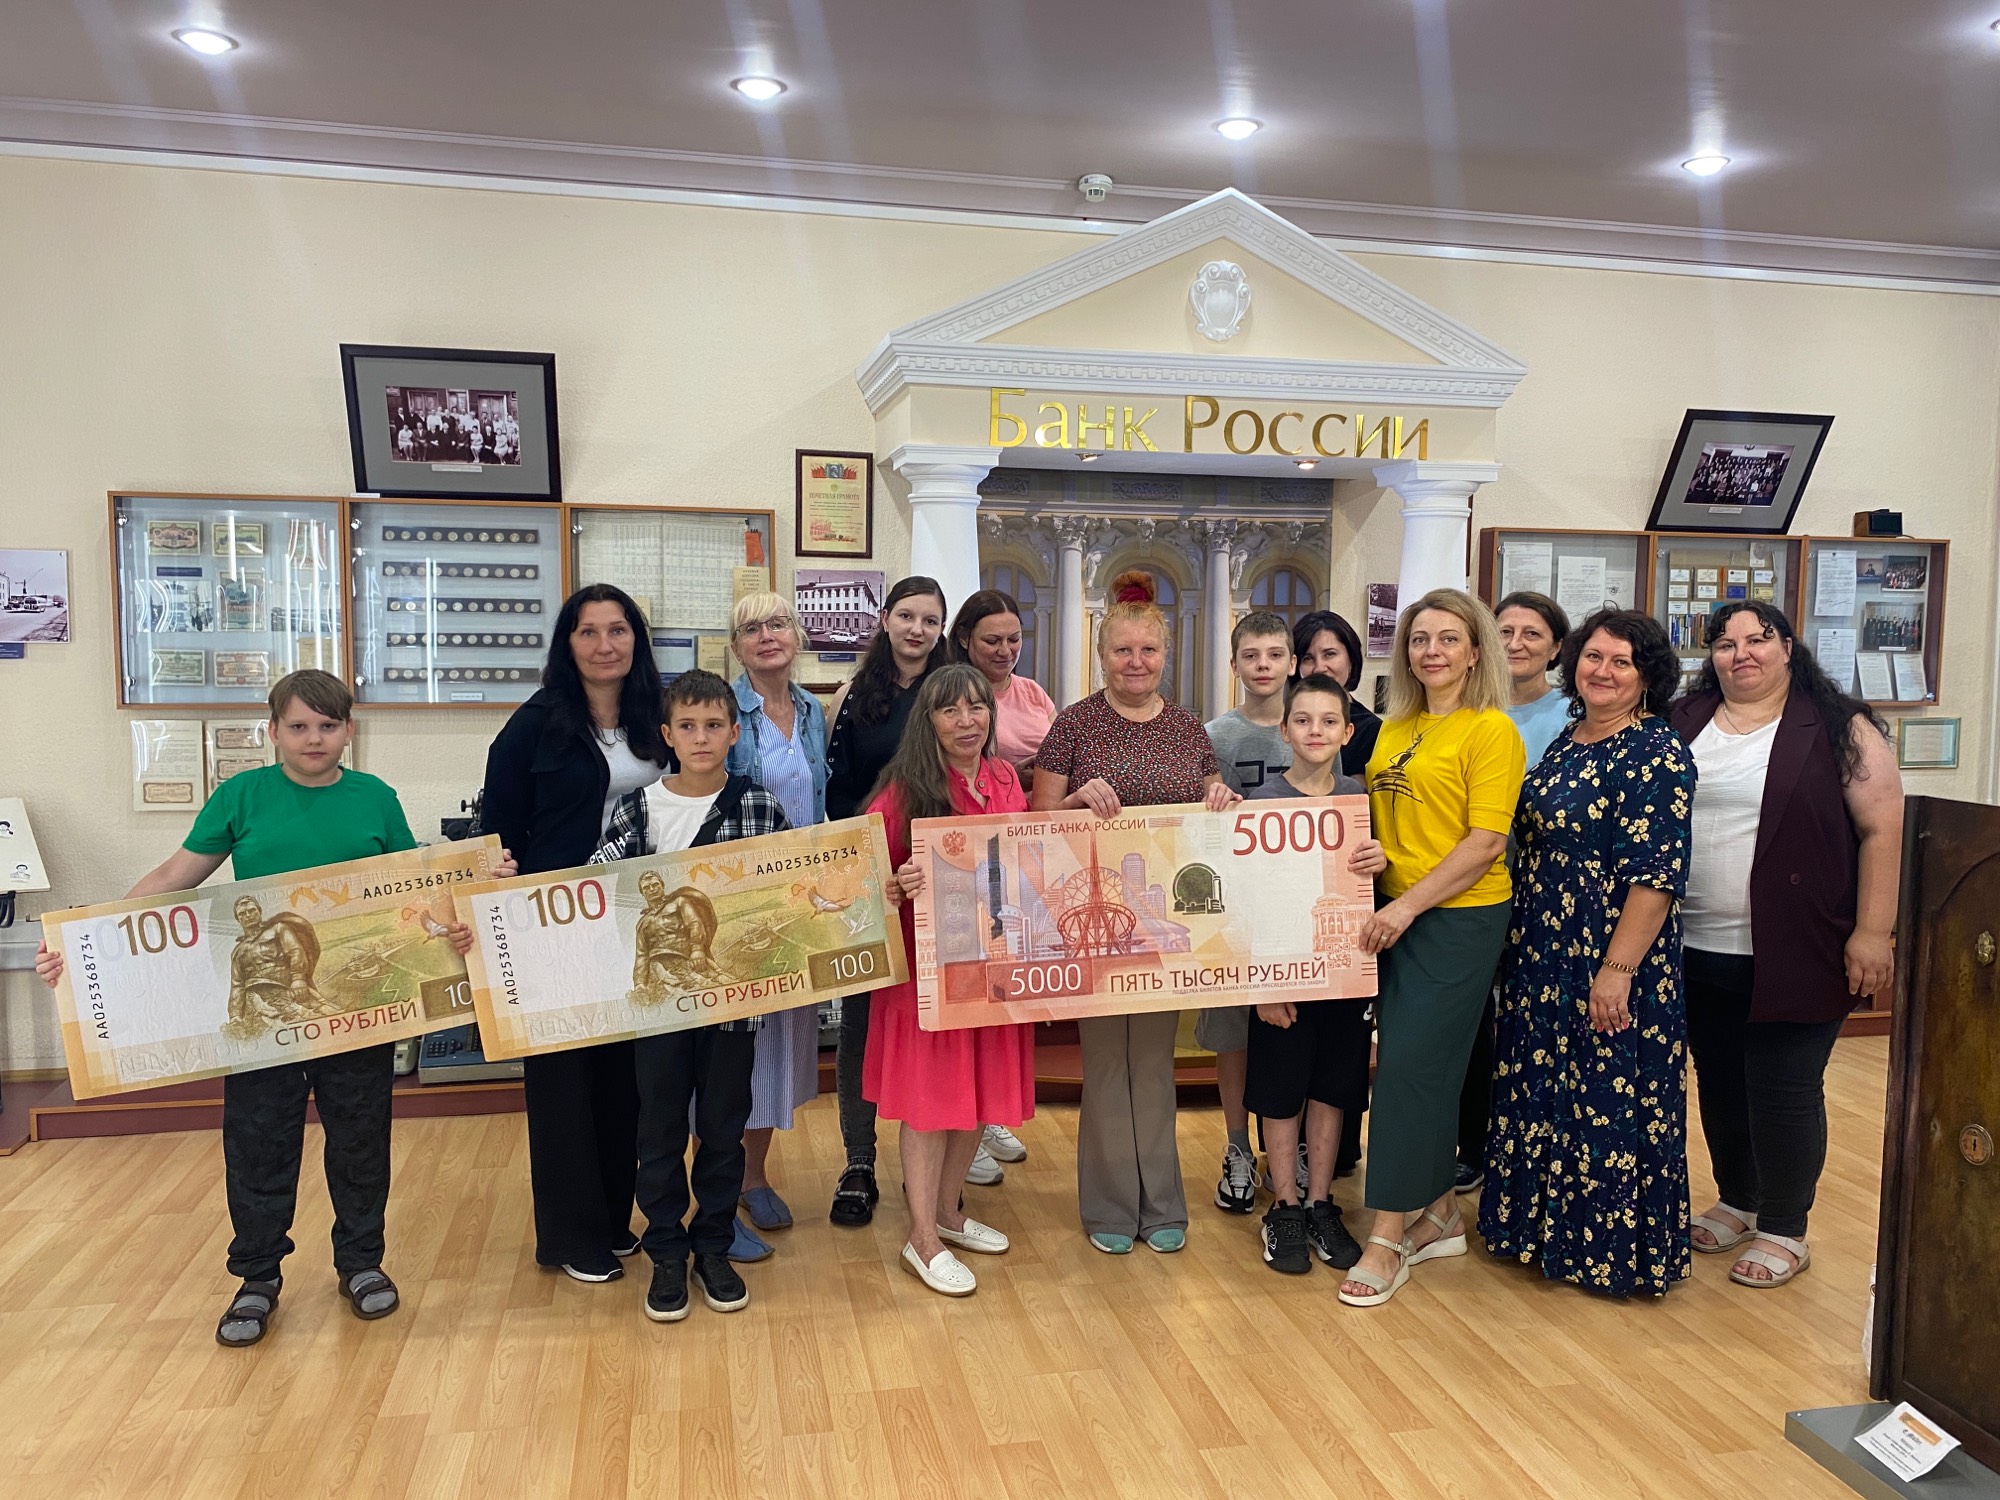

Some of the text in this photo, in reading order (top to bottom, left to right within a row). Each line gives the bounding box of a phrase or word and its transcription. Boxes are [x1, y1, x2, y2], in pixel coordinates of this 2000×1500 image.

[989, 387, 1429, 460] Банк России
[860, 827, 872, 849] 2022
[1006, 818, 1146, 838] БИЛЕТ БАНКА РОССИИ
[1232, 808, 1345, 856] 5000
[477, 849, 489, 872] 2022
[527, 879, 606, 928] 100
[118, 905, 199, 957] 100
[829, 949, 875, 981] 100
[1010, 963, 1082, 996] 5000
[1110, 956, 1326, 994] ПЯТЬ ТЫСЯЧ РУБЛЕЙ
[444, 980, 473, 1010] 10
[676, 969, 805, 1013] СТО РУБЛЕЙ
[275, 999, 418, 1048] СТО РУБЛЕЙ
